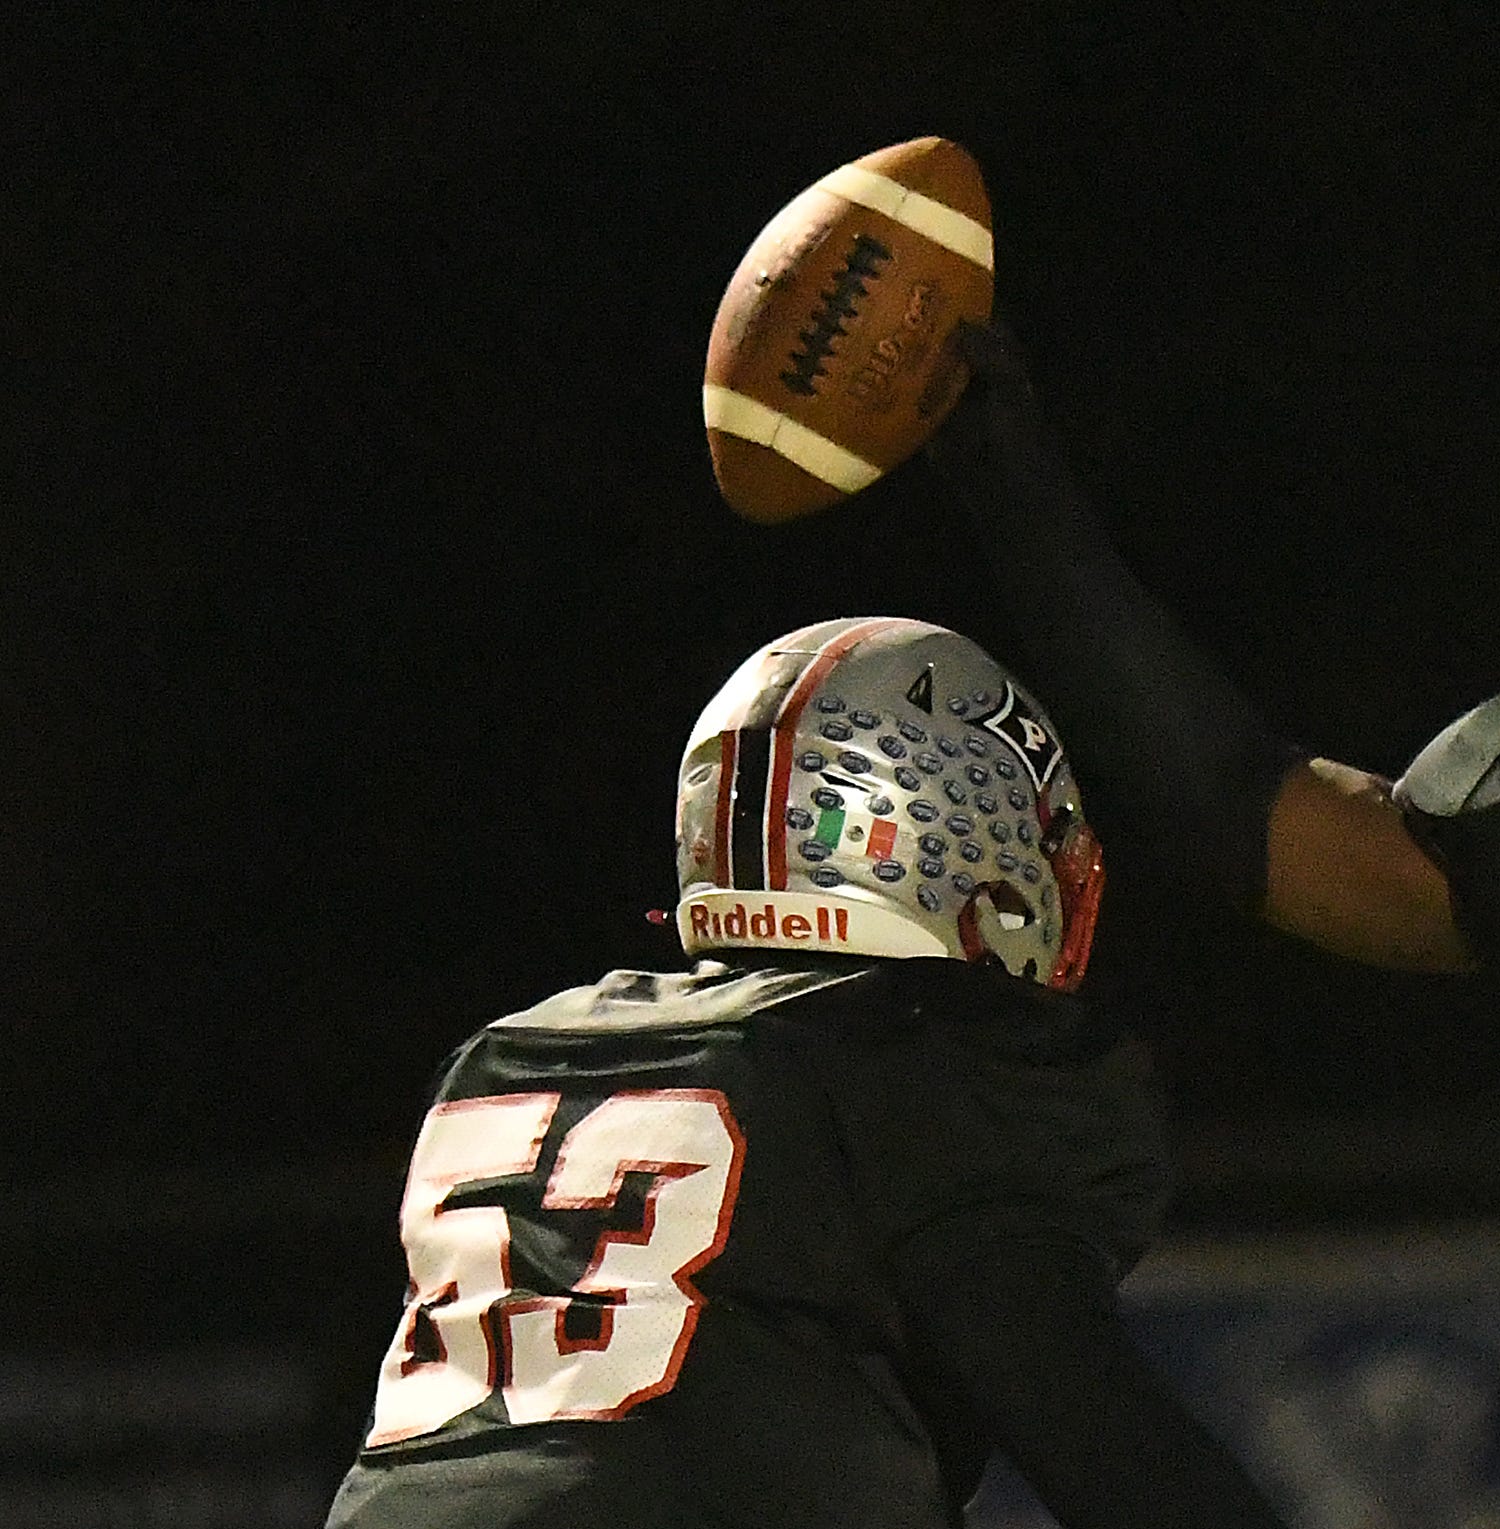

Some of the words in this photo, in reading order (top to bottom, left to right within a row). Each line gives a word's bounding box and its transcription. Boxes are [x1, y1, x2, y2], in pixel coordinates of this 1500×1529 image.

[1017, 716, 1047, 751] P
[690, 902, 849, 942] Riddell
[366, 1087, 748, 1449] 53
